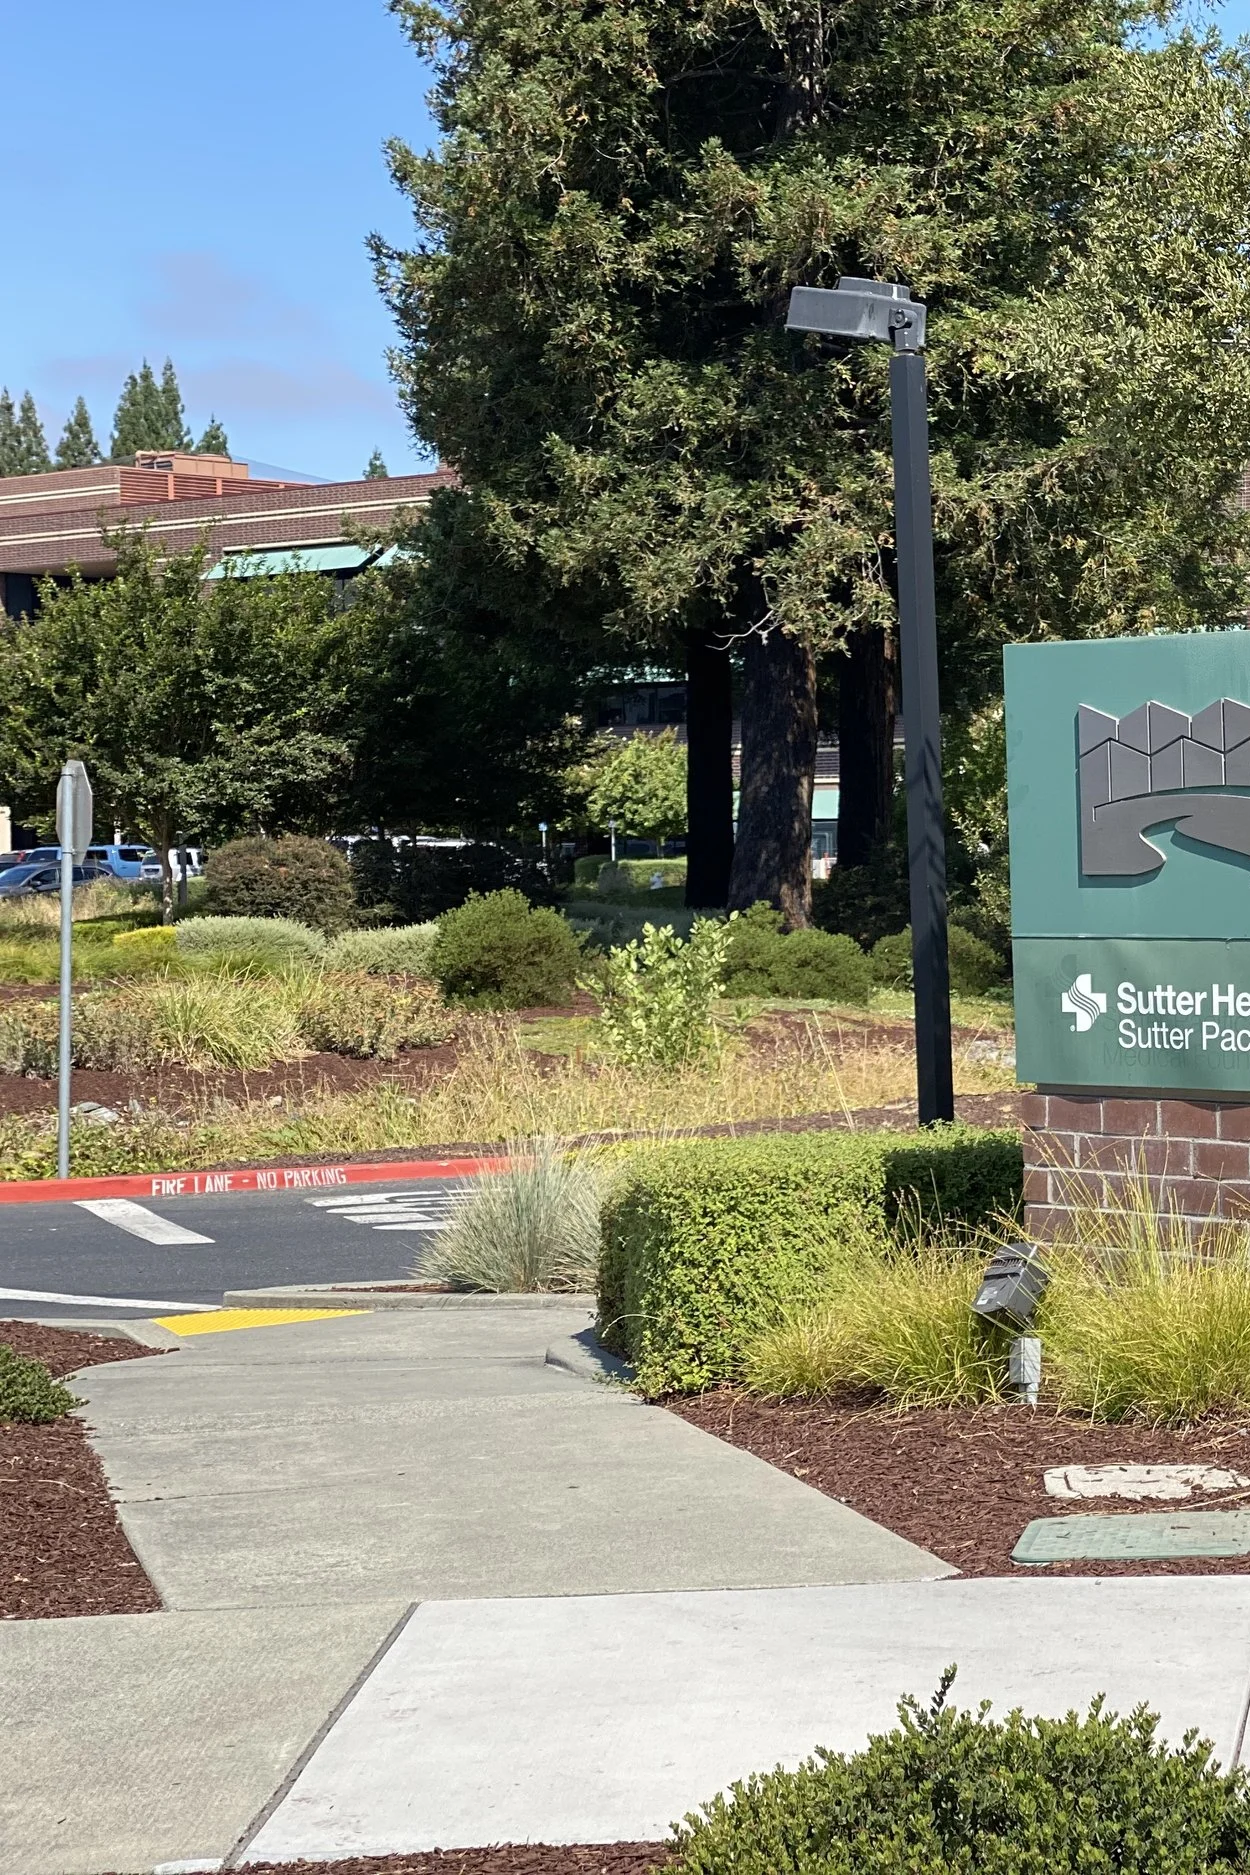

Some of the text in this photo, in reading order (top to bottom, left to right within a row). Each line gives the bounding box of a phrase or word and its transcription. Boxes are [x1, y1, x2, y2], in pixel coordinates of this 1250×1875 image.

[1116, 981, 1208, 1016] Sutter
[1118, 1018, 1194, 1050] Sutter
[256, 1171, 278, 1190] NO
[283, 1167, 347, 1188] PARKING
